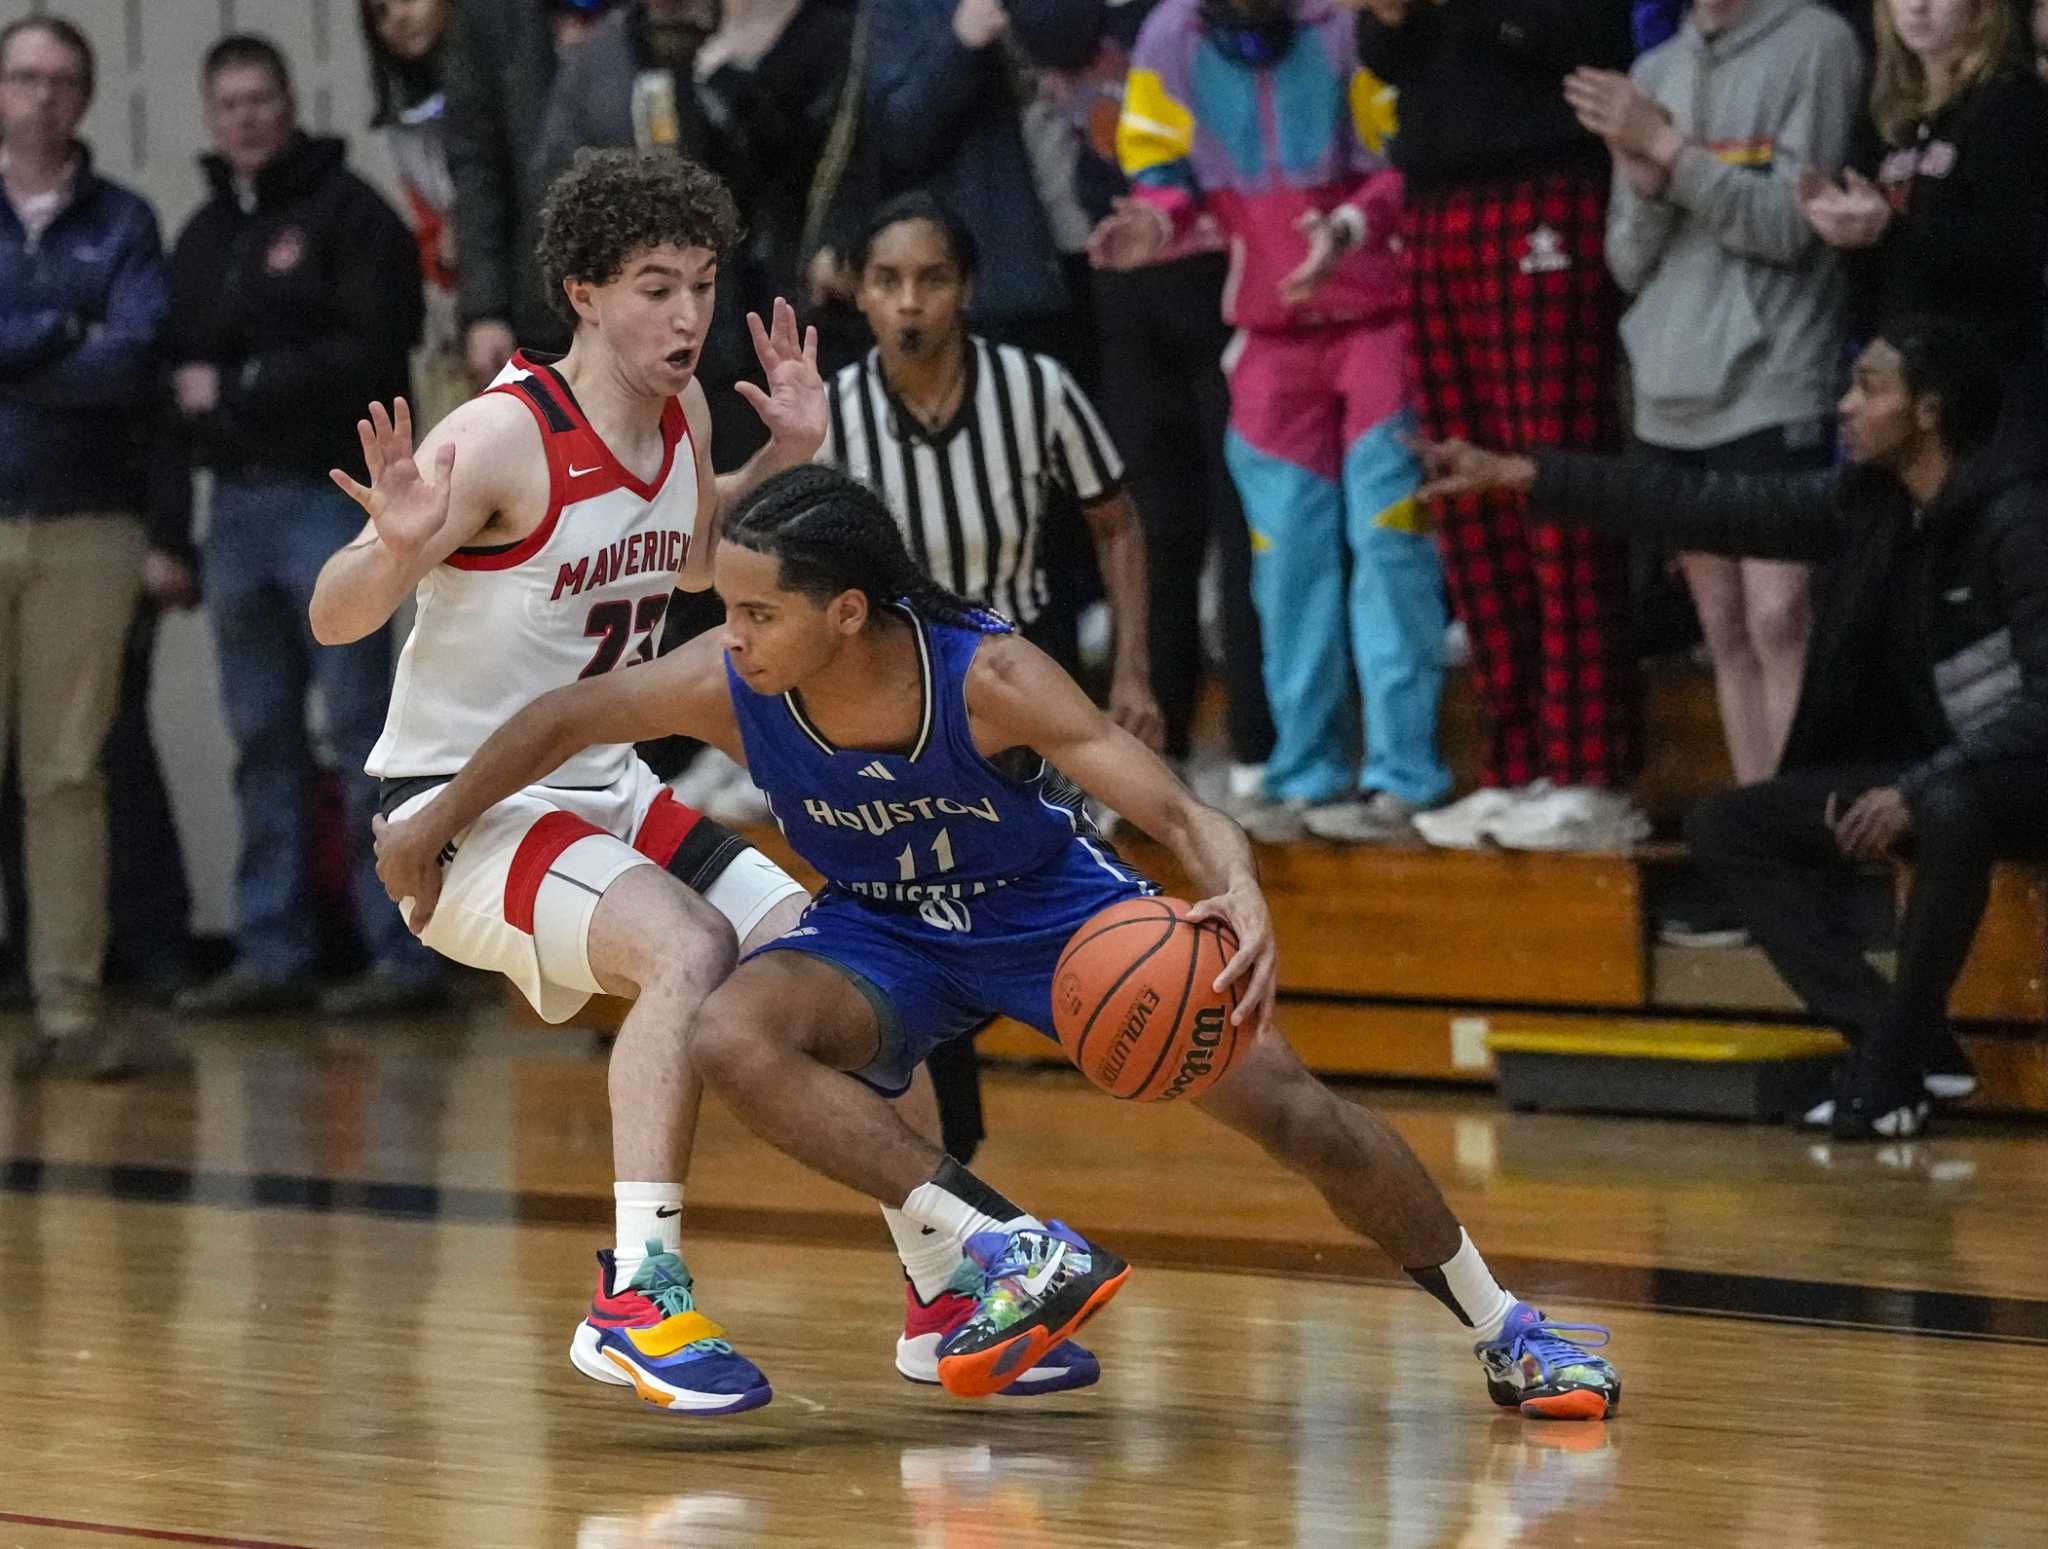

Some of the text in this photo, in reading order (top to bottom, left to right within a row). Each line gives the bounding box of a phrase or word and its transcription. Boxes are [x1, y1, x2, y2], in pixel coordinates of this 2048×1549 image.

[578, 593, 669, 681] 23
[803, 797, 1000, 836] HOUSTON
[896, 827, 955, 881] 11
